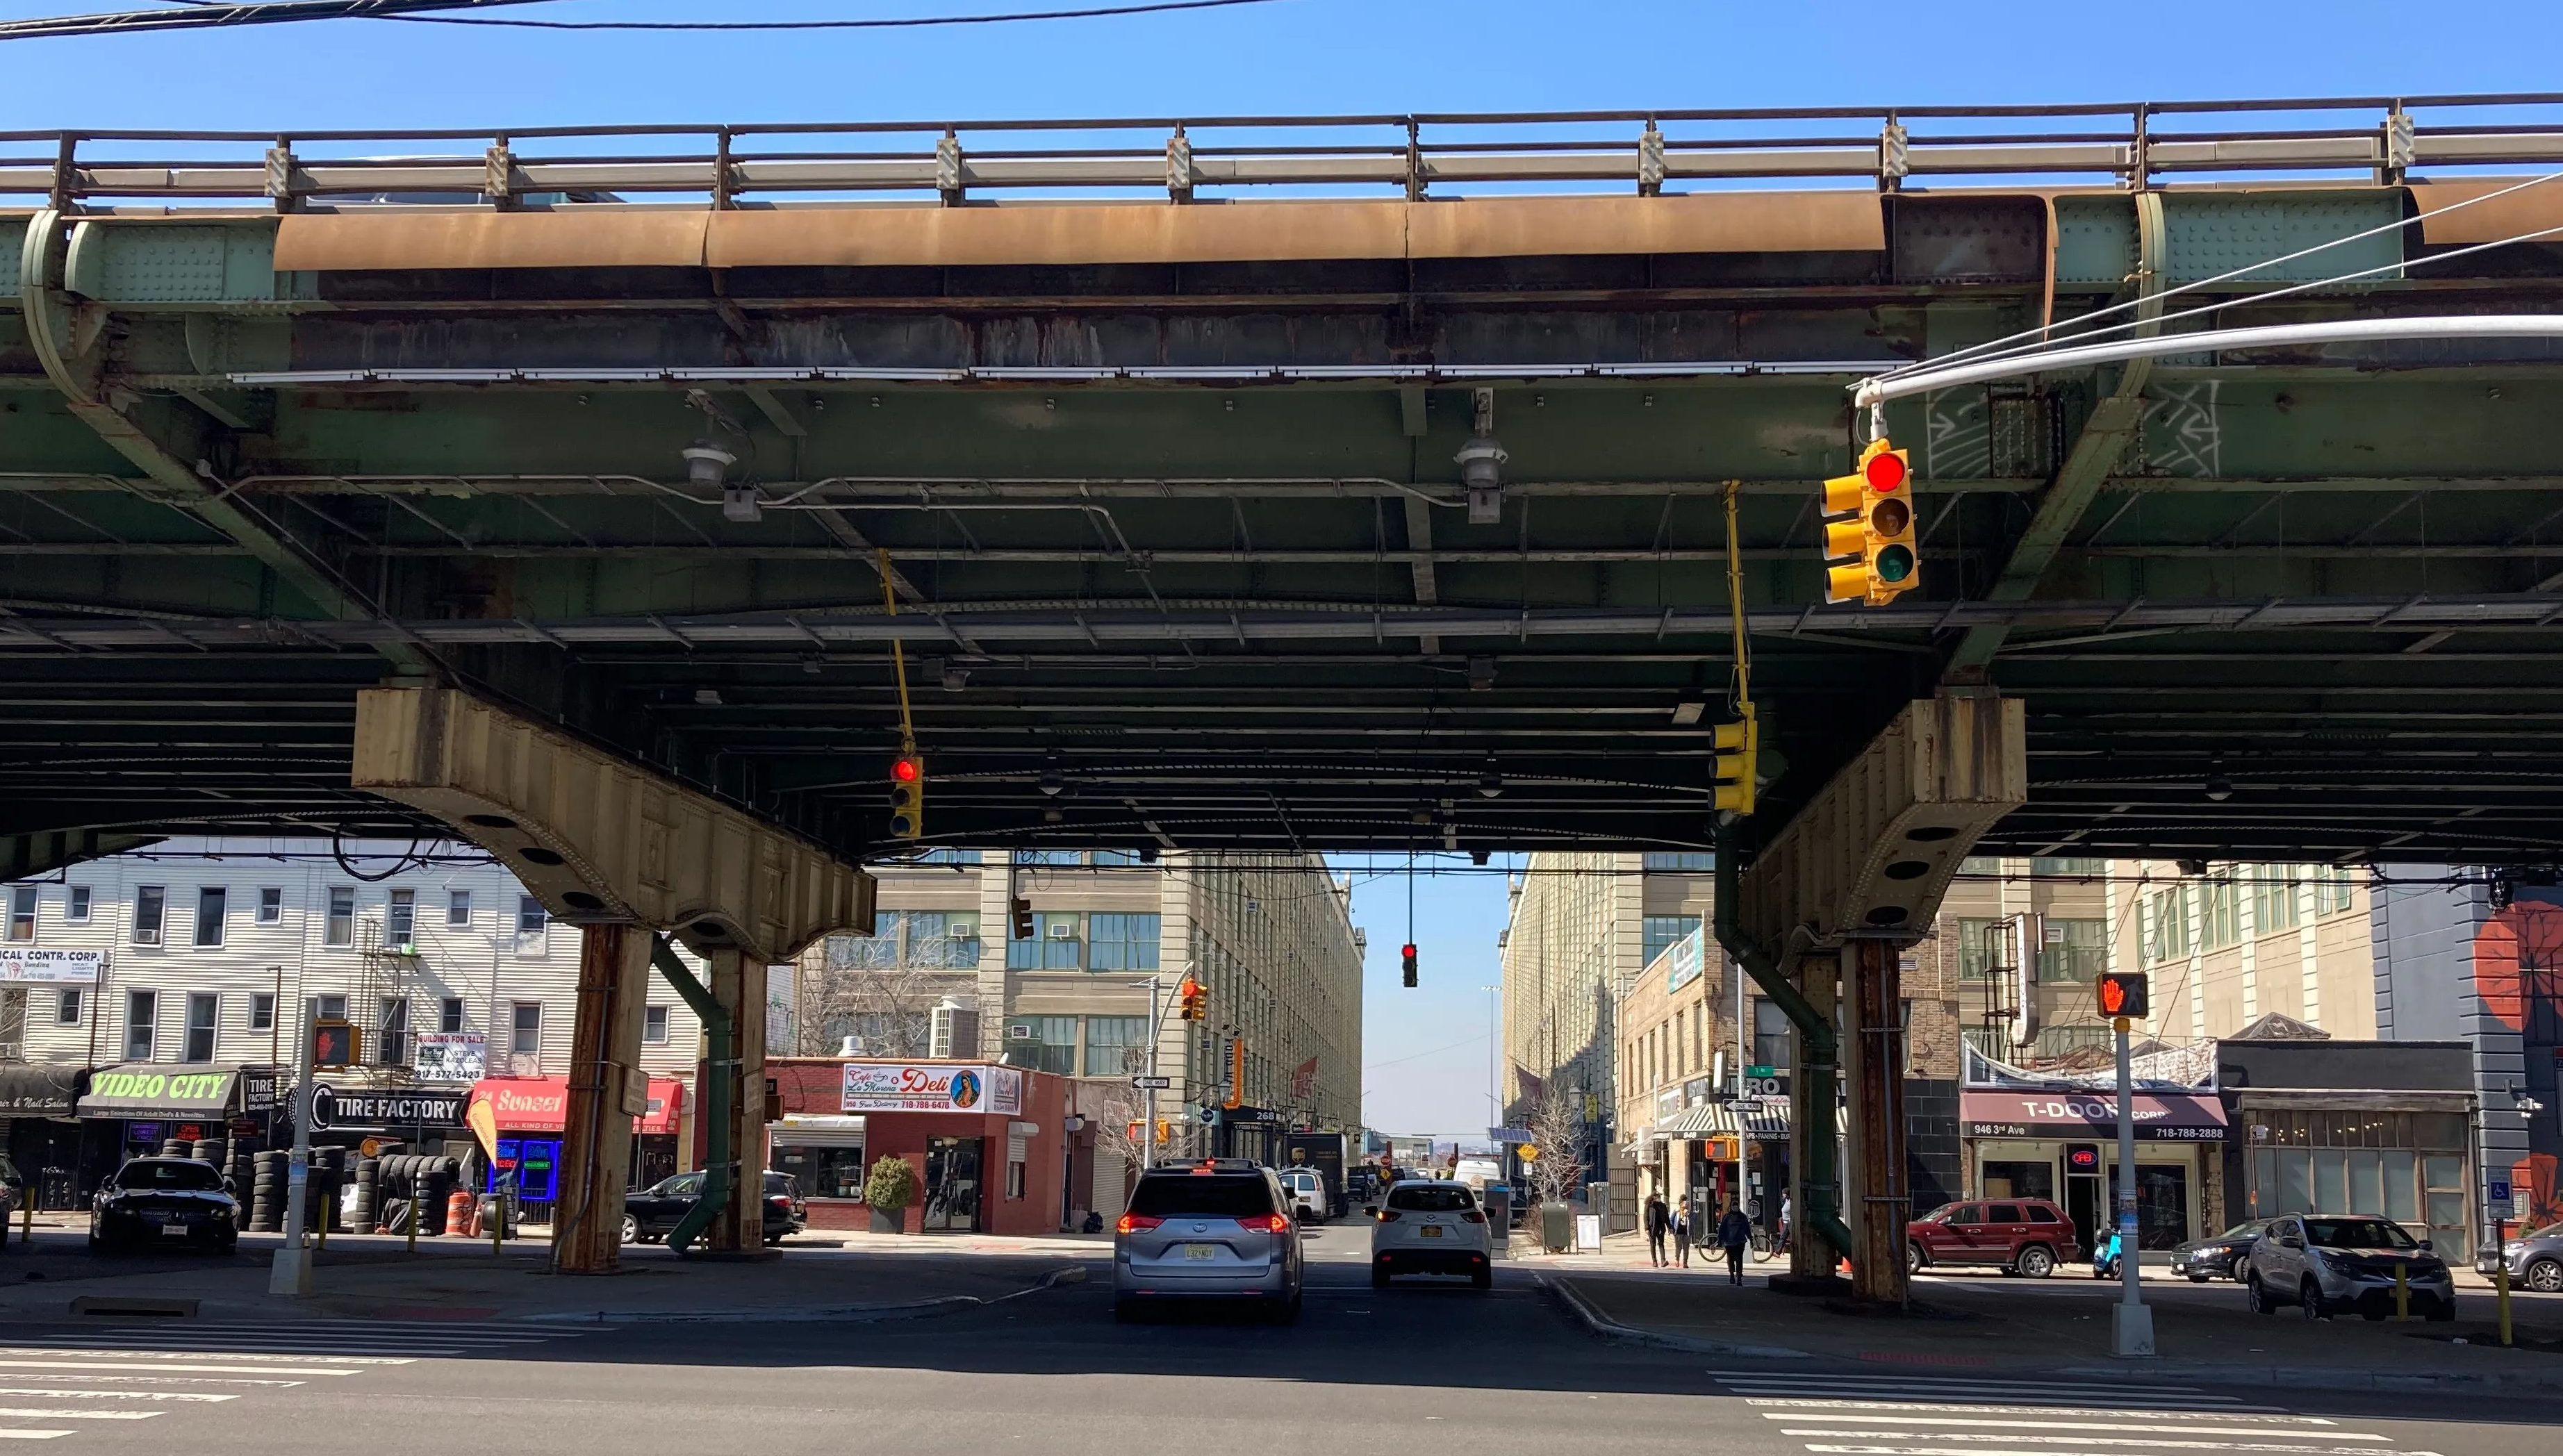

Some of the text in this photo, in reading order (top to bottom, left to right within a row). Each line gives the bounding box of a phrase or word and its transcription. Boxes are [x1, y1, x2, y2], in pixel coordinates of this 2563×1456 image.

[27, 950, 67, 960] CONTR.
[69, 952, 100, 961] CORP.
[418, 1034, 485, 1044] BUILDING FOR SALE
[92, 1073, 228, 1099] VIDEO CITY
[249, 1079, 274, 1093] TIRE
[900, 1068, 950, 1093] Deli
[847, 1081, 897, 1092] La Morena
[13, 1097, 21, 1107] &
[24, 1097, 44, 1109] Nail
[44, 1097, 69, 1108] Salon
[248, 1093, 274, 1102] FACTORY
[497, 1089, 563, 1112] Sunset
[336, 1098, 458, 1119] TIRE FACTORY
[858, 1100, 873, 1109] Free
[873, 1099, 898, 1108] Delivery
[901, 1100, 950, 1109] 718-788-6478
[1256, 1111, 1275, 1120] 268
[2132, 1111, 2169, 1120] CORP.
[1974, 1124, 2025, 1135] 946 3rd Ave
[2156, 1127, 2224, 1139] 718-788-2888
